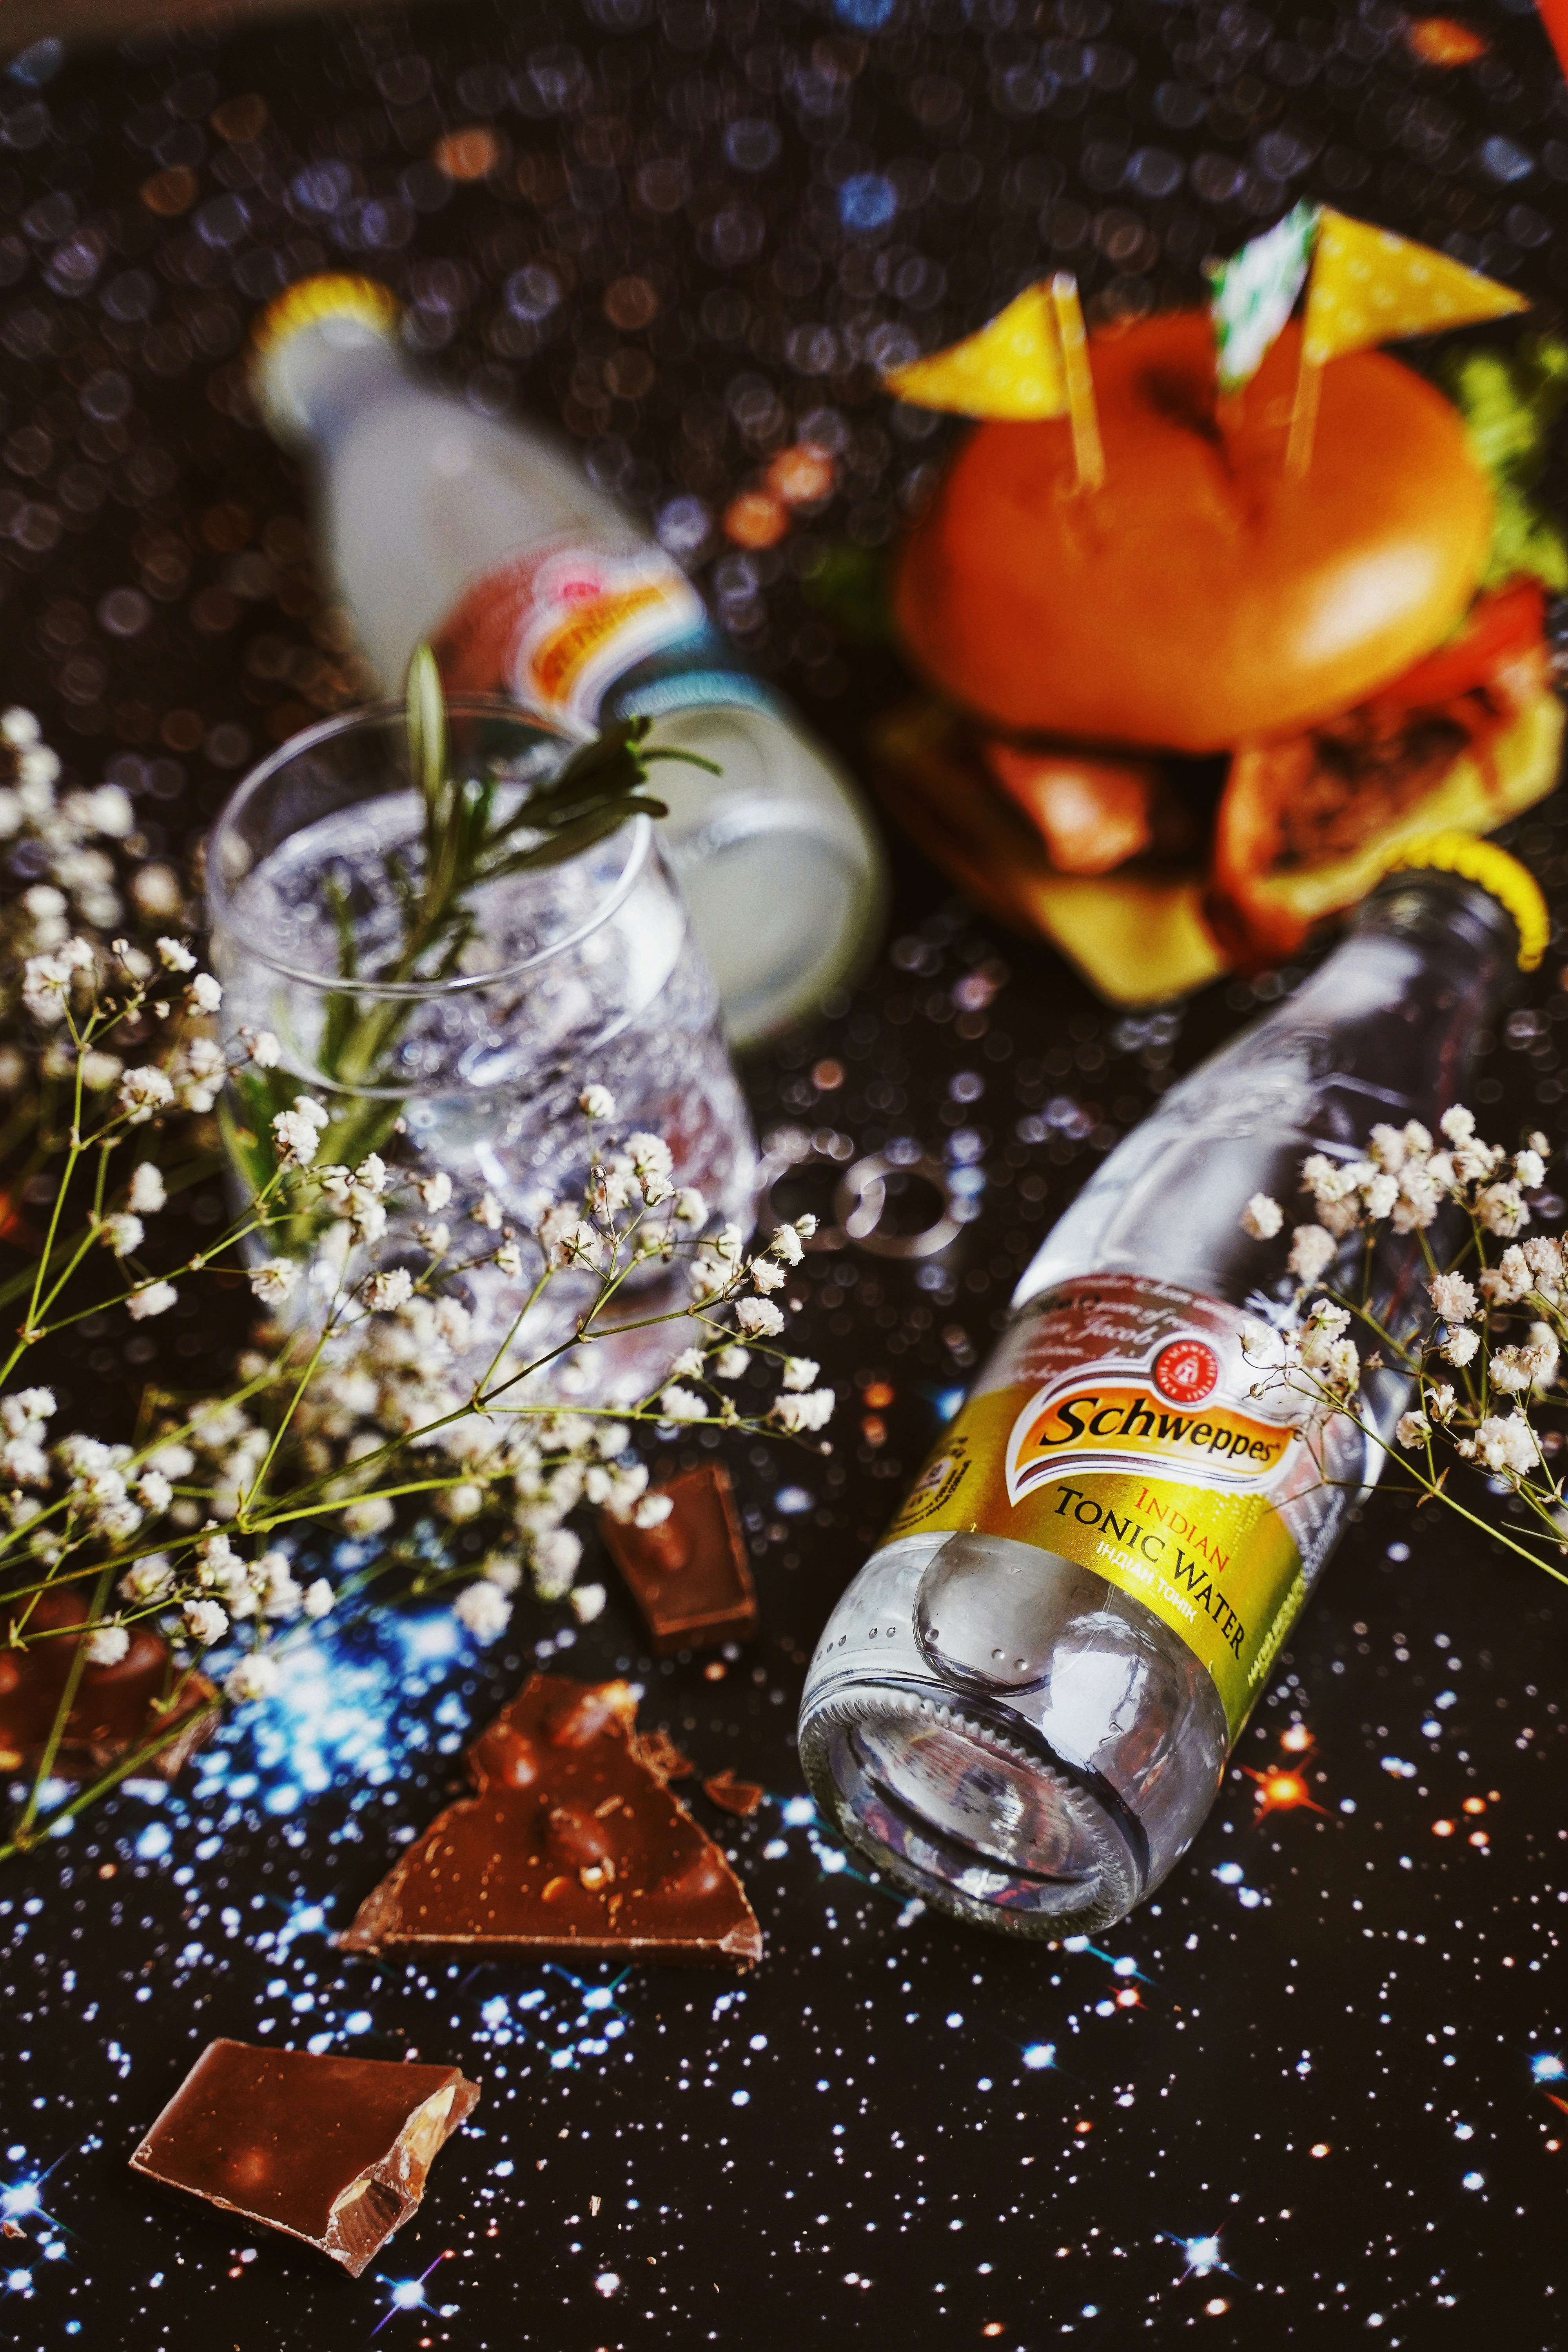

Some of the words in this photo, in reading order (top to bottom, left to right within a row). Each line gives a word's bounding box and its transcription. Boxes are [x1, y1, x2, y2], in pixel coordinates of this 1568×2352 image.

[1040, 1398, 1275, 1461] Schweppes
[1134, 1487, 1230, 1573] INDIAN
[1054, 1486, 1165, 1563] TONIC
[1174, 1548, 1245, 1659] WATER
[1157, 1577, 1198, 1624] ТОНІК
